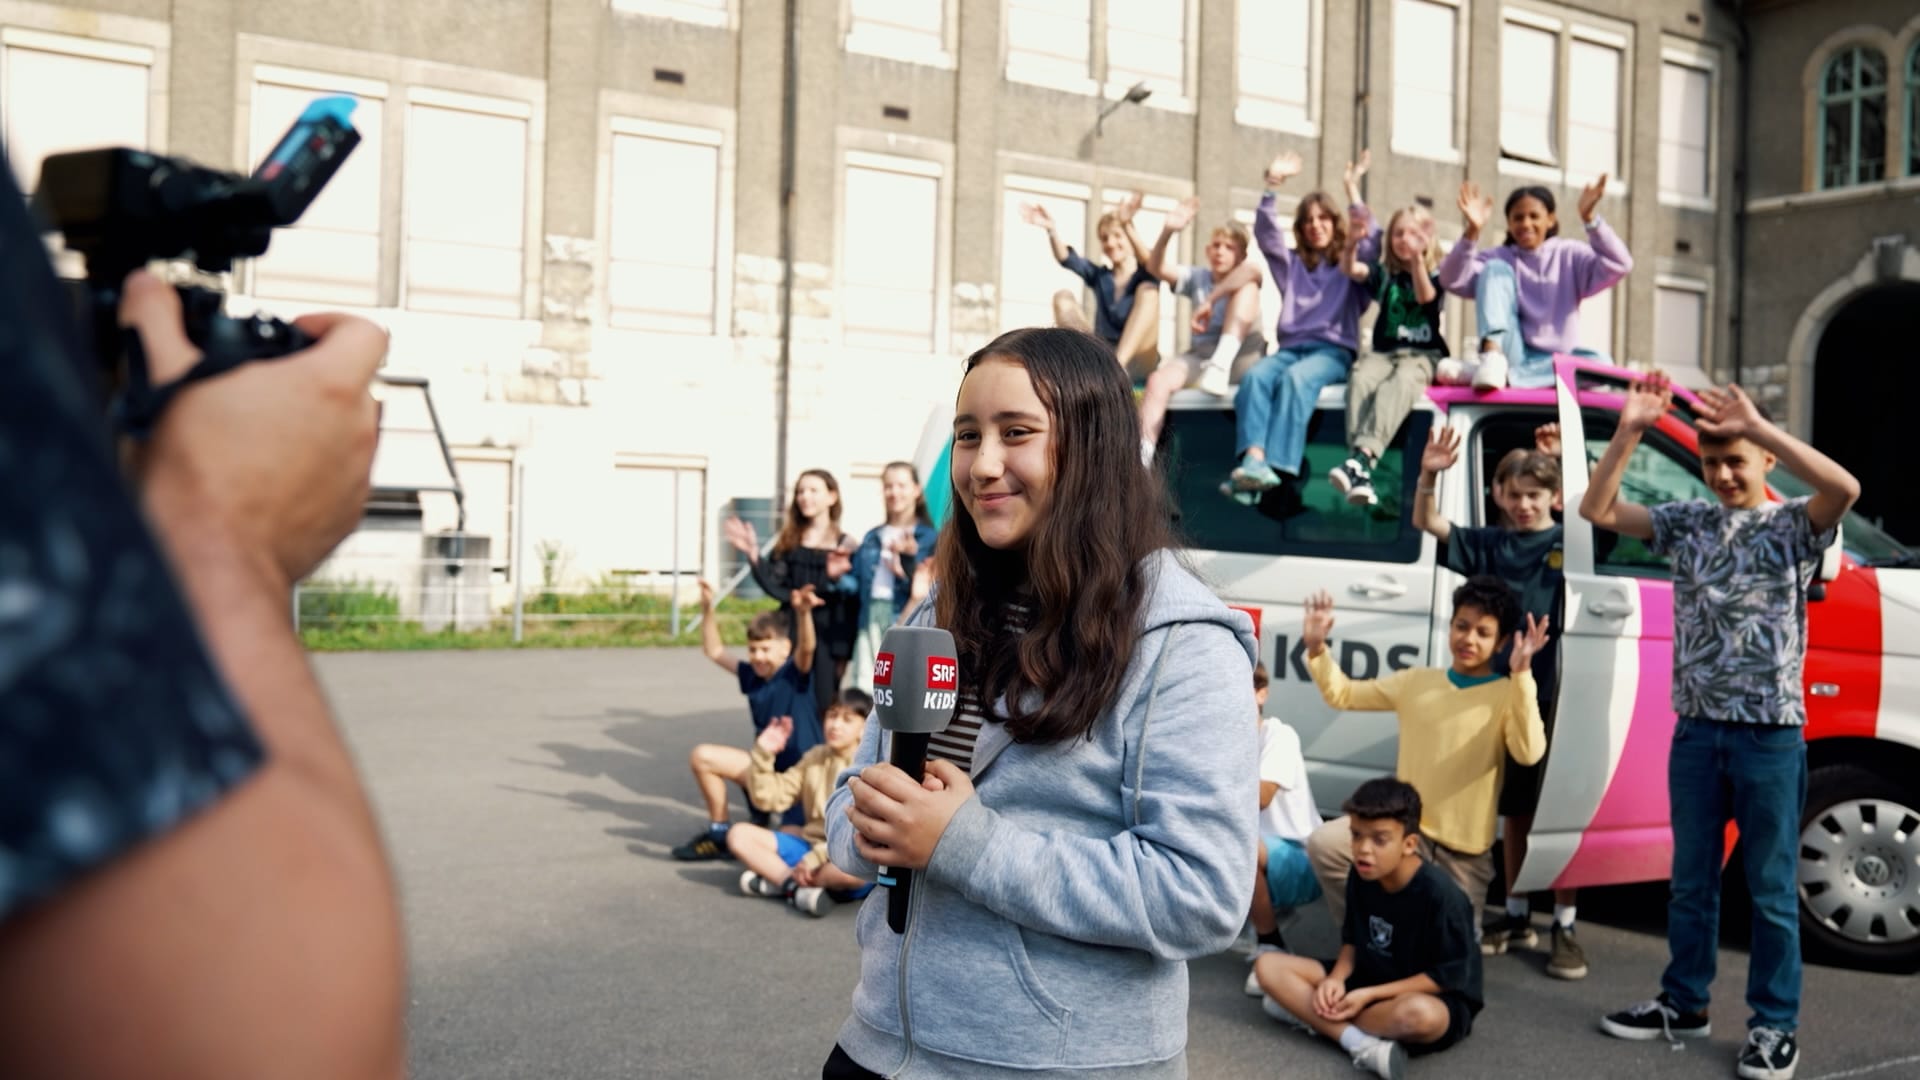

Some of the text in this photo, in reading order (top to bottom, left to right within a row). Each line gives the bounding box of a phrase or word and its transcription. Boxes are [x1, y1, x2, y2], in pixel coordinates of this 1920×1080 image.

[1274, 634, 1420, 682] KDS
[932, 664, 955, 682] SRF
[873, 689, 893, 707] iDS
